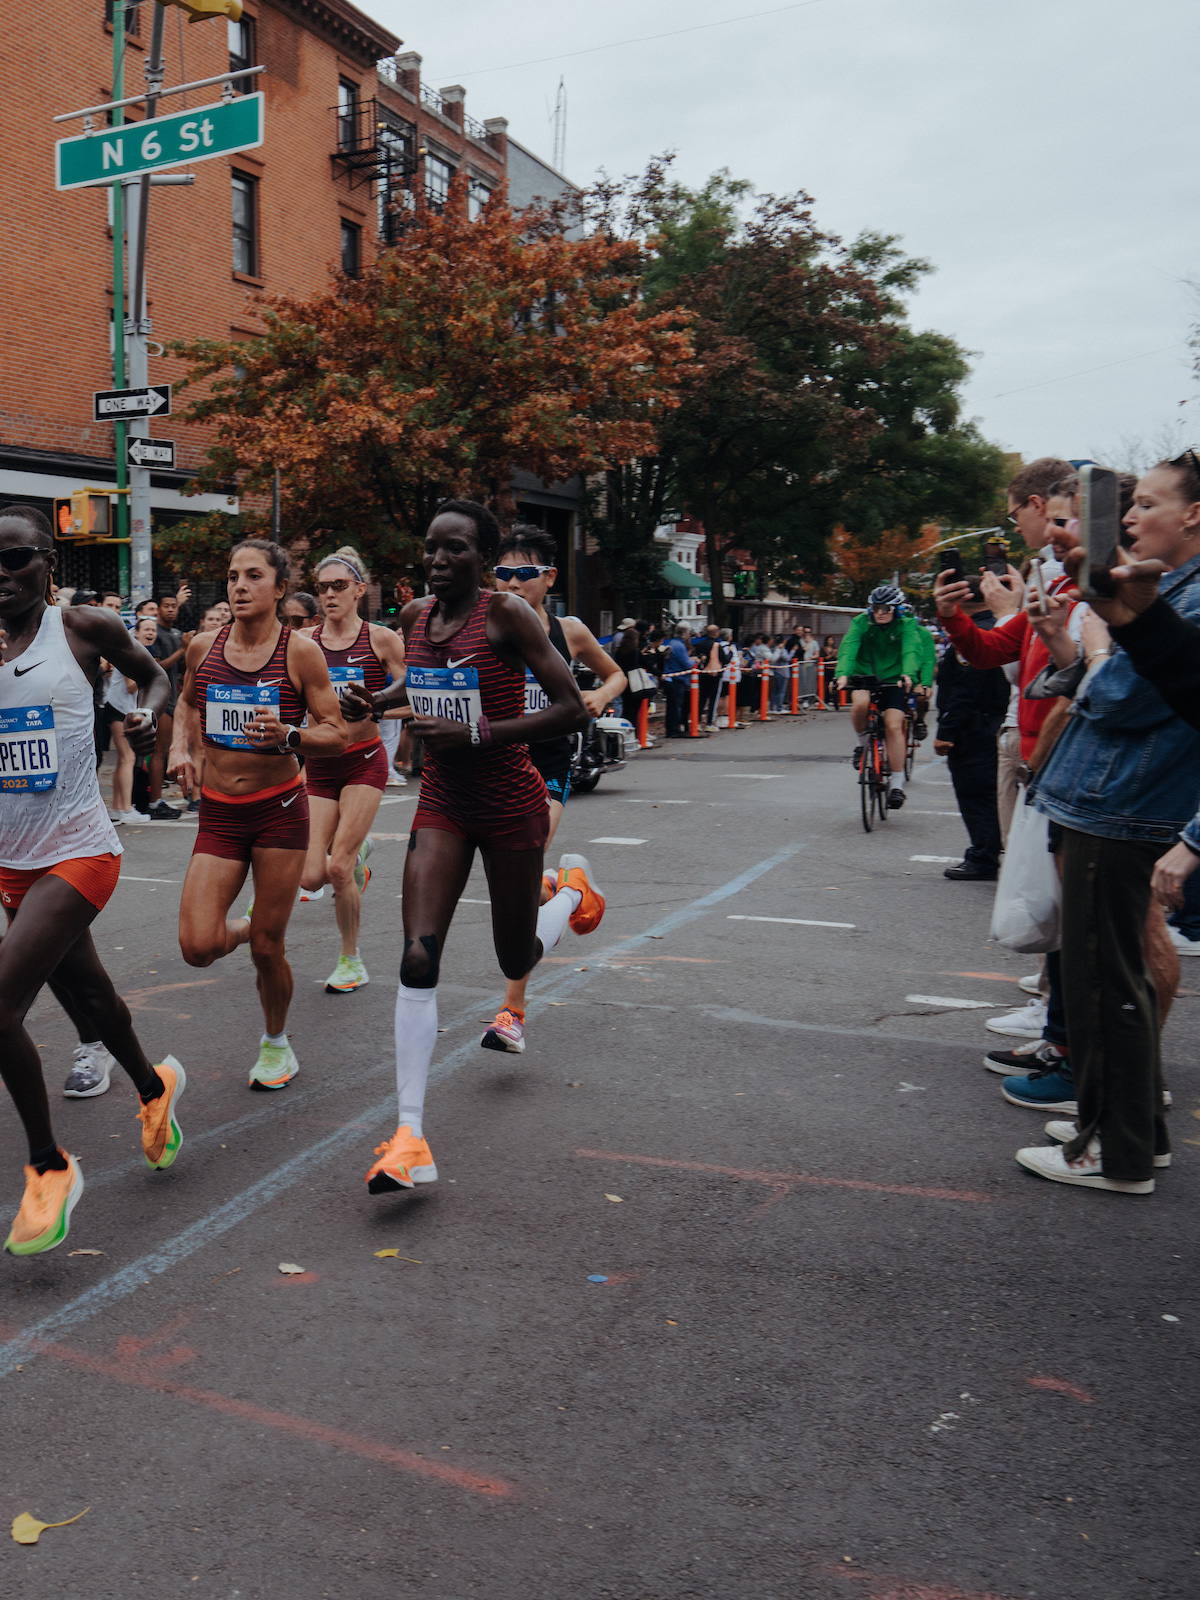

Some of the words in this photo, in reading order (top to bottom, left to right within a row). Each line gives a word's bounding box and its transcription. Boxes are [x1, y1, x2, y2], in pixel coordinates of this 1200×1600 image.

[102, 139, 123, 169] N
[141, 130, 162, 160] 6
[179, 118, 214, 152] St
[105, 399, 126, 411] ONE
[136, 395, 158, 408] WAY
[215, 689, 230, 700] tcs
[232, 737, 255, 746] 202
[2, 779, 28, 788] 2022
